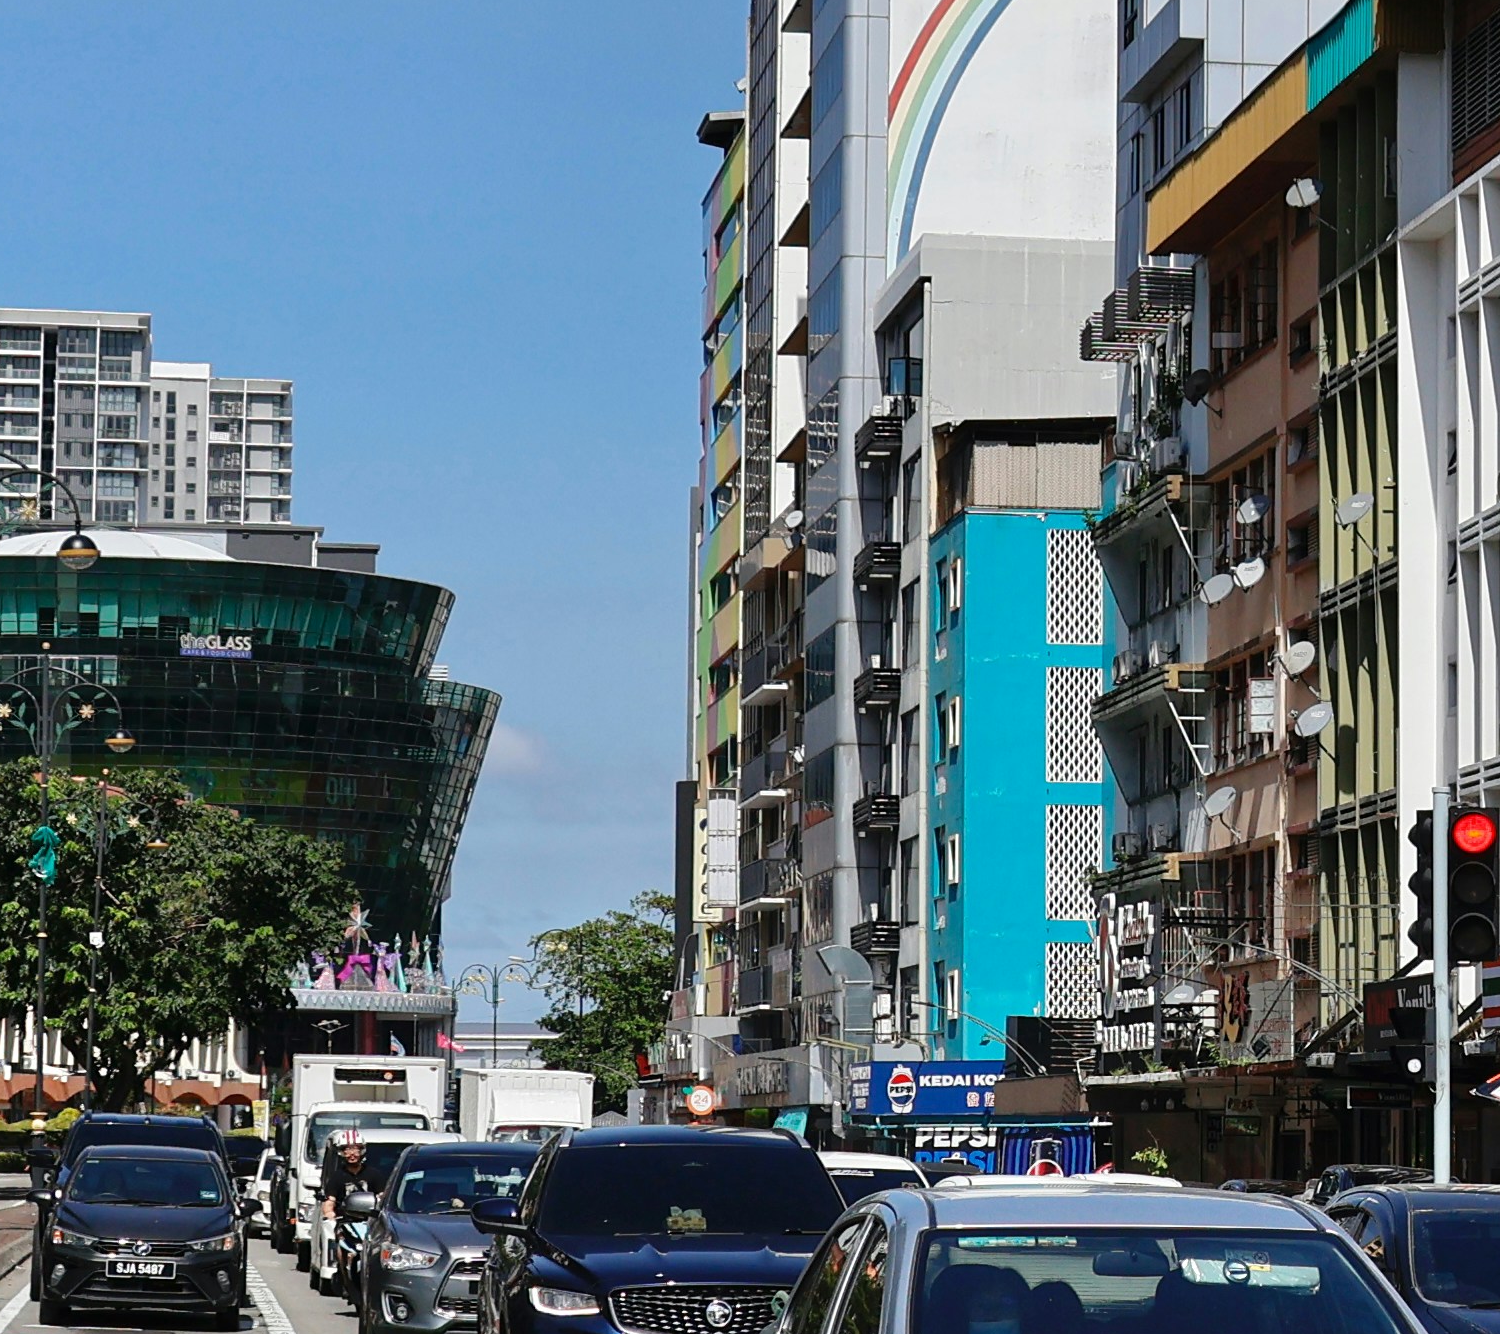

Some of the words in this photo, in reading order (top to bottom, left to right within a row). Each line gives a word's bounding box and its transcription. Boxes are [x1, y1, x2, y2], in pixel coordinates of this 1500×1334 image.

[918, 1075, 970, 1087] KEDAI
[694, 1094, 708, 1105] 24
[915, 1127, 998, 1148] PEPSI
[116, 1263, 137, 1274] SJA
[138, 1264, 165, 1275] 5487
